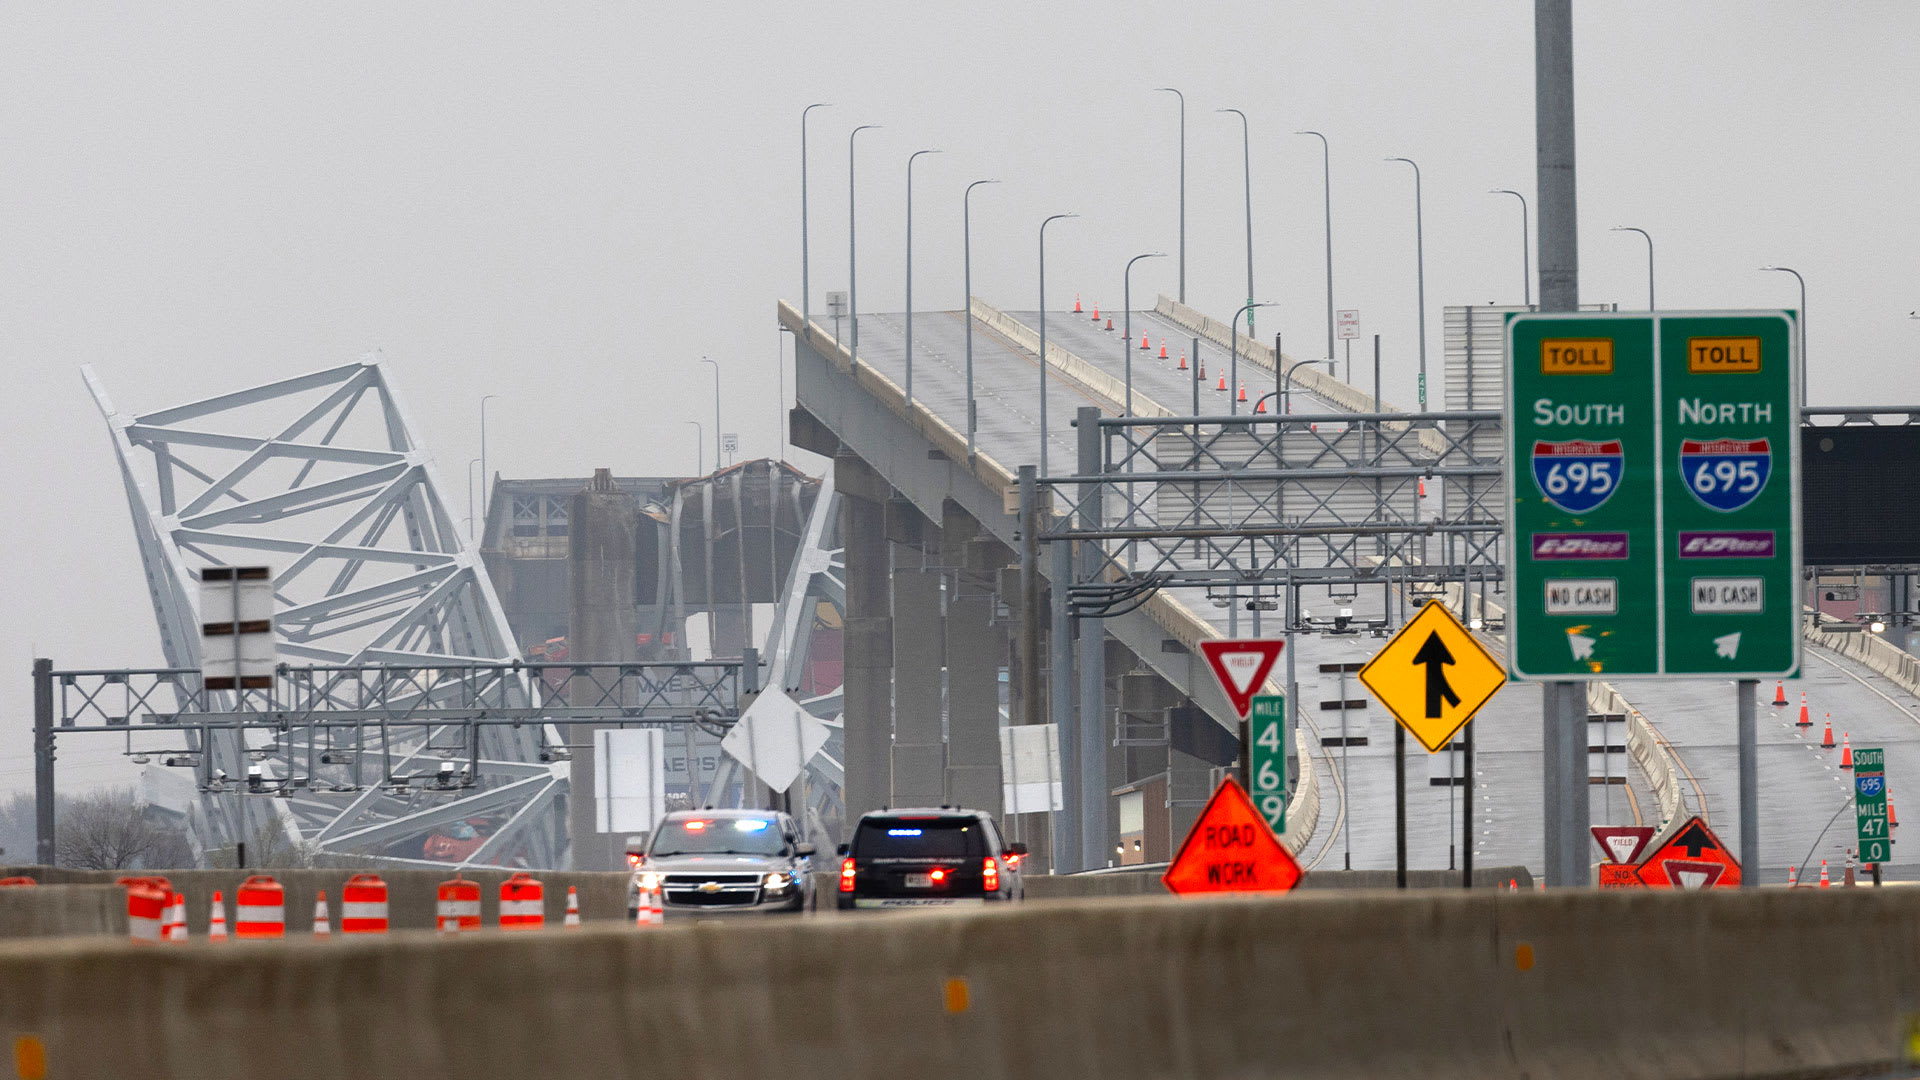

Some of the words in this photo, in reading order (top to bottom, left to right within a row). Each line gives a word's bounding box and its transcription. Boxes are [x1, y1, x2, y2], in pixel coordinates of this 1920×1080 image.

[1549, 347, 1606, 365] TOLL
[1696, 346, 1753, 363] TOLL
[1533, 398, 1625, 425] SOUTH
[1678, 397, 1772, 424] NORTH
[1545, 462, 1612, 495] 695
[1694, 461, 1760, 493] 695
[1551, 588, 1570, 606] NO
[1574, 587, 1611, 605] CASH
[1697, 587, 1716, 604] NO
[1721, 586, 1758, 604] CASH
[1255, 701, 1281, 716] MILE
[1854, 751, 1883, 766] SOUTH
[1860, 778, 1880, 792] 695
[1858, 803, 1885, 817] MILE
[1206, 824, 1255, 848] ROAD
[1861, 818, 1884, 836] 47
[1614, 838, 1633, 846] YIELD
[1208, 862, 1258, 885] WORK
[1614, 870, 1630, 879] NO
